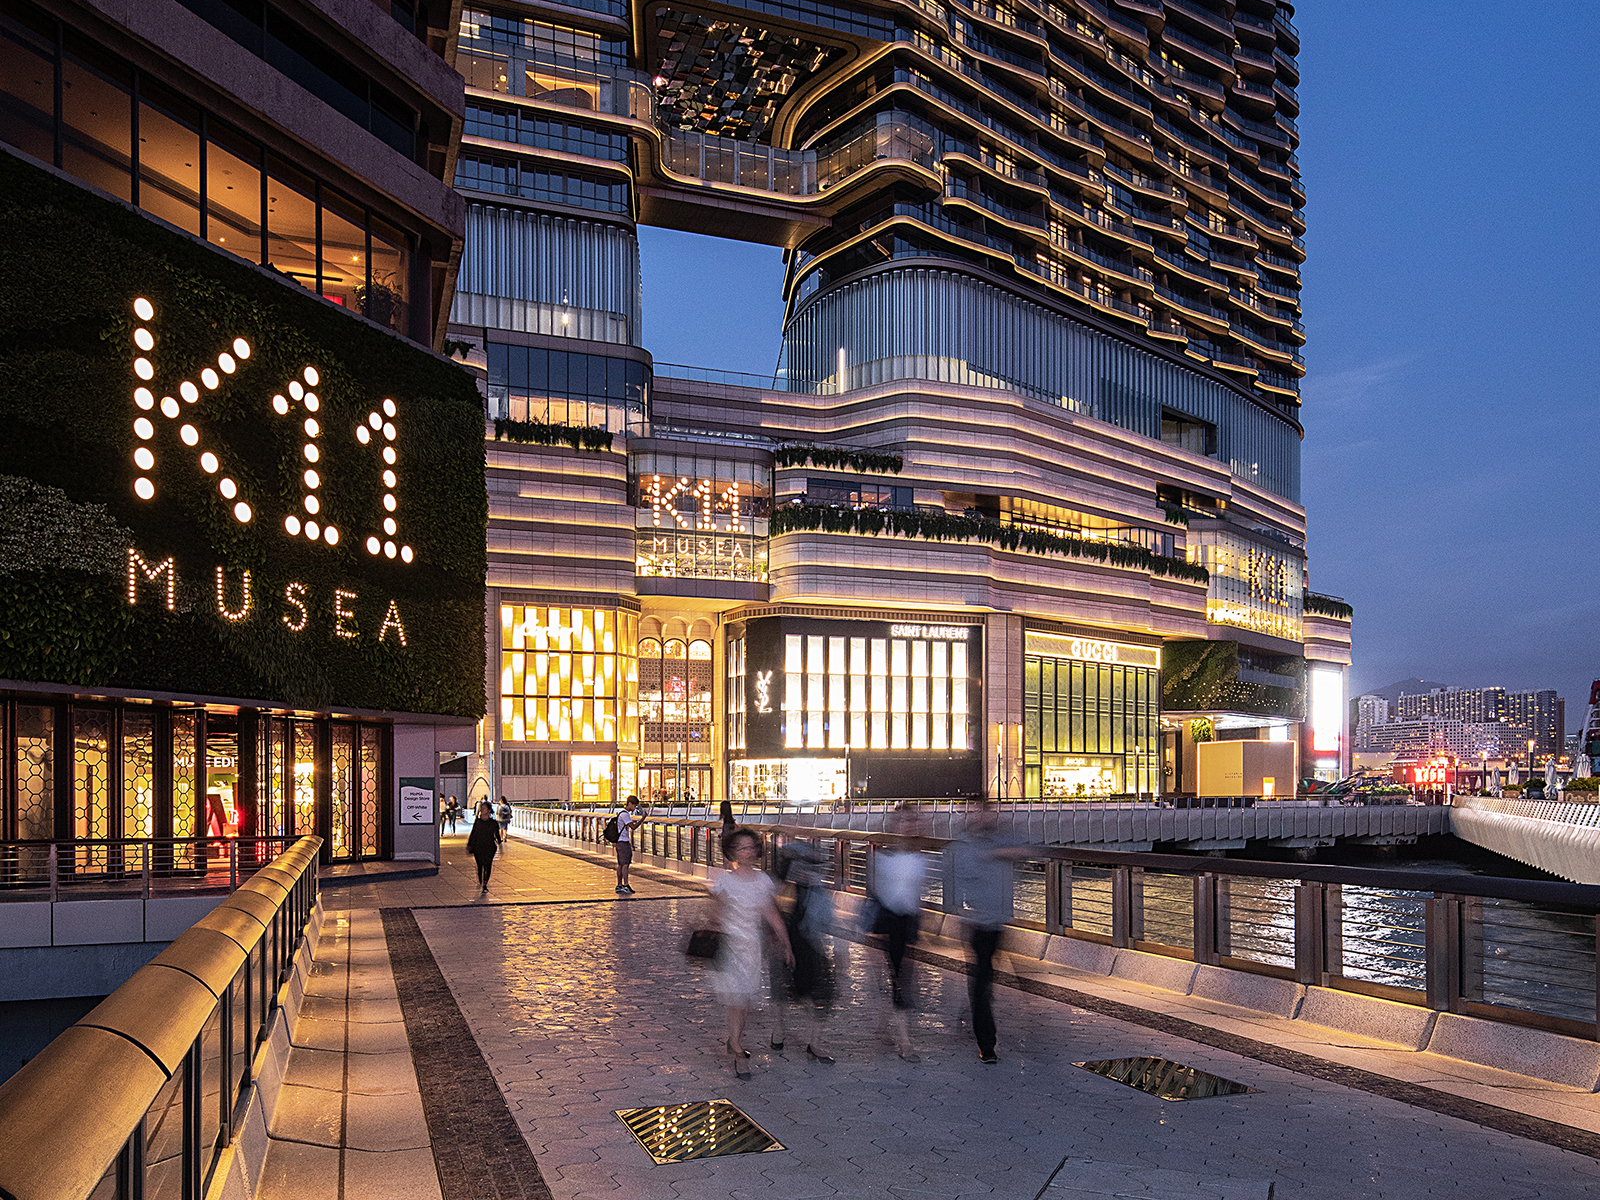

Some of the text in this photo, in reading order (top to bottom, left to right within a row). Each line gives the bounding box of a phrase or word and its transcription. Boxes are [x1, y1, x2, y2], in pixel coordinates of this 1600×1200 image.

[134, 297, 414, 563] K11
[652, 474, 746, 532] K11
[653, 536, 745, 557] MUSEA
[128, 548, 407, 646] MUSEA
[1248, 548, 1288, 608] K11
[891, 624, 969, 639] SAINT LAURENT
[1071, 641, 1118, 661] GUCCI
